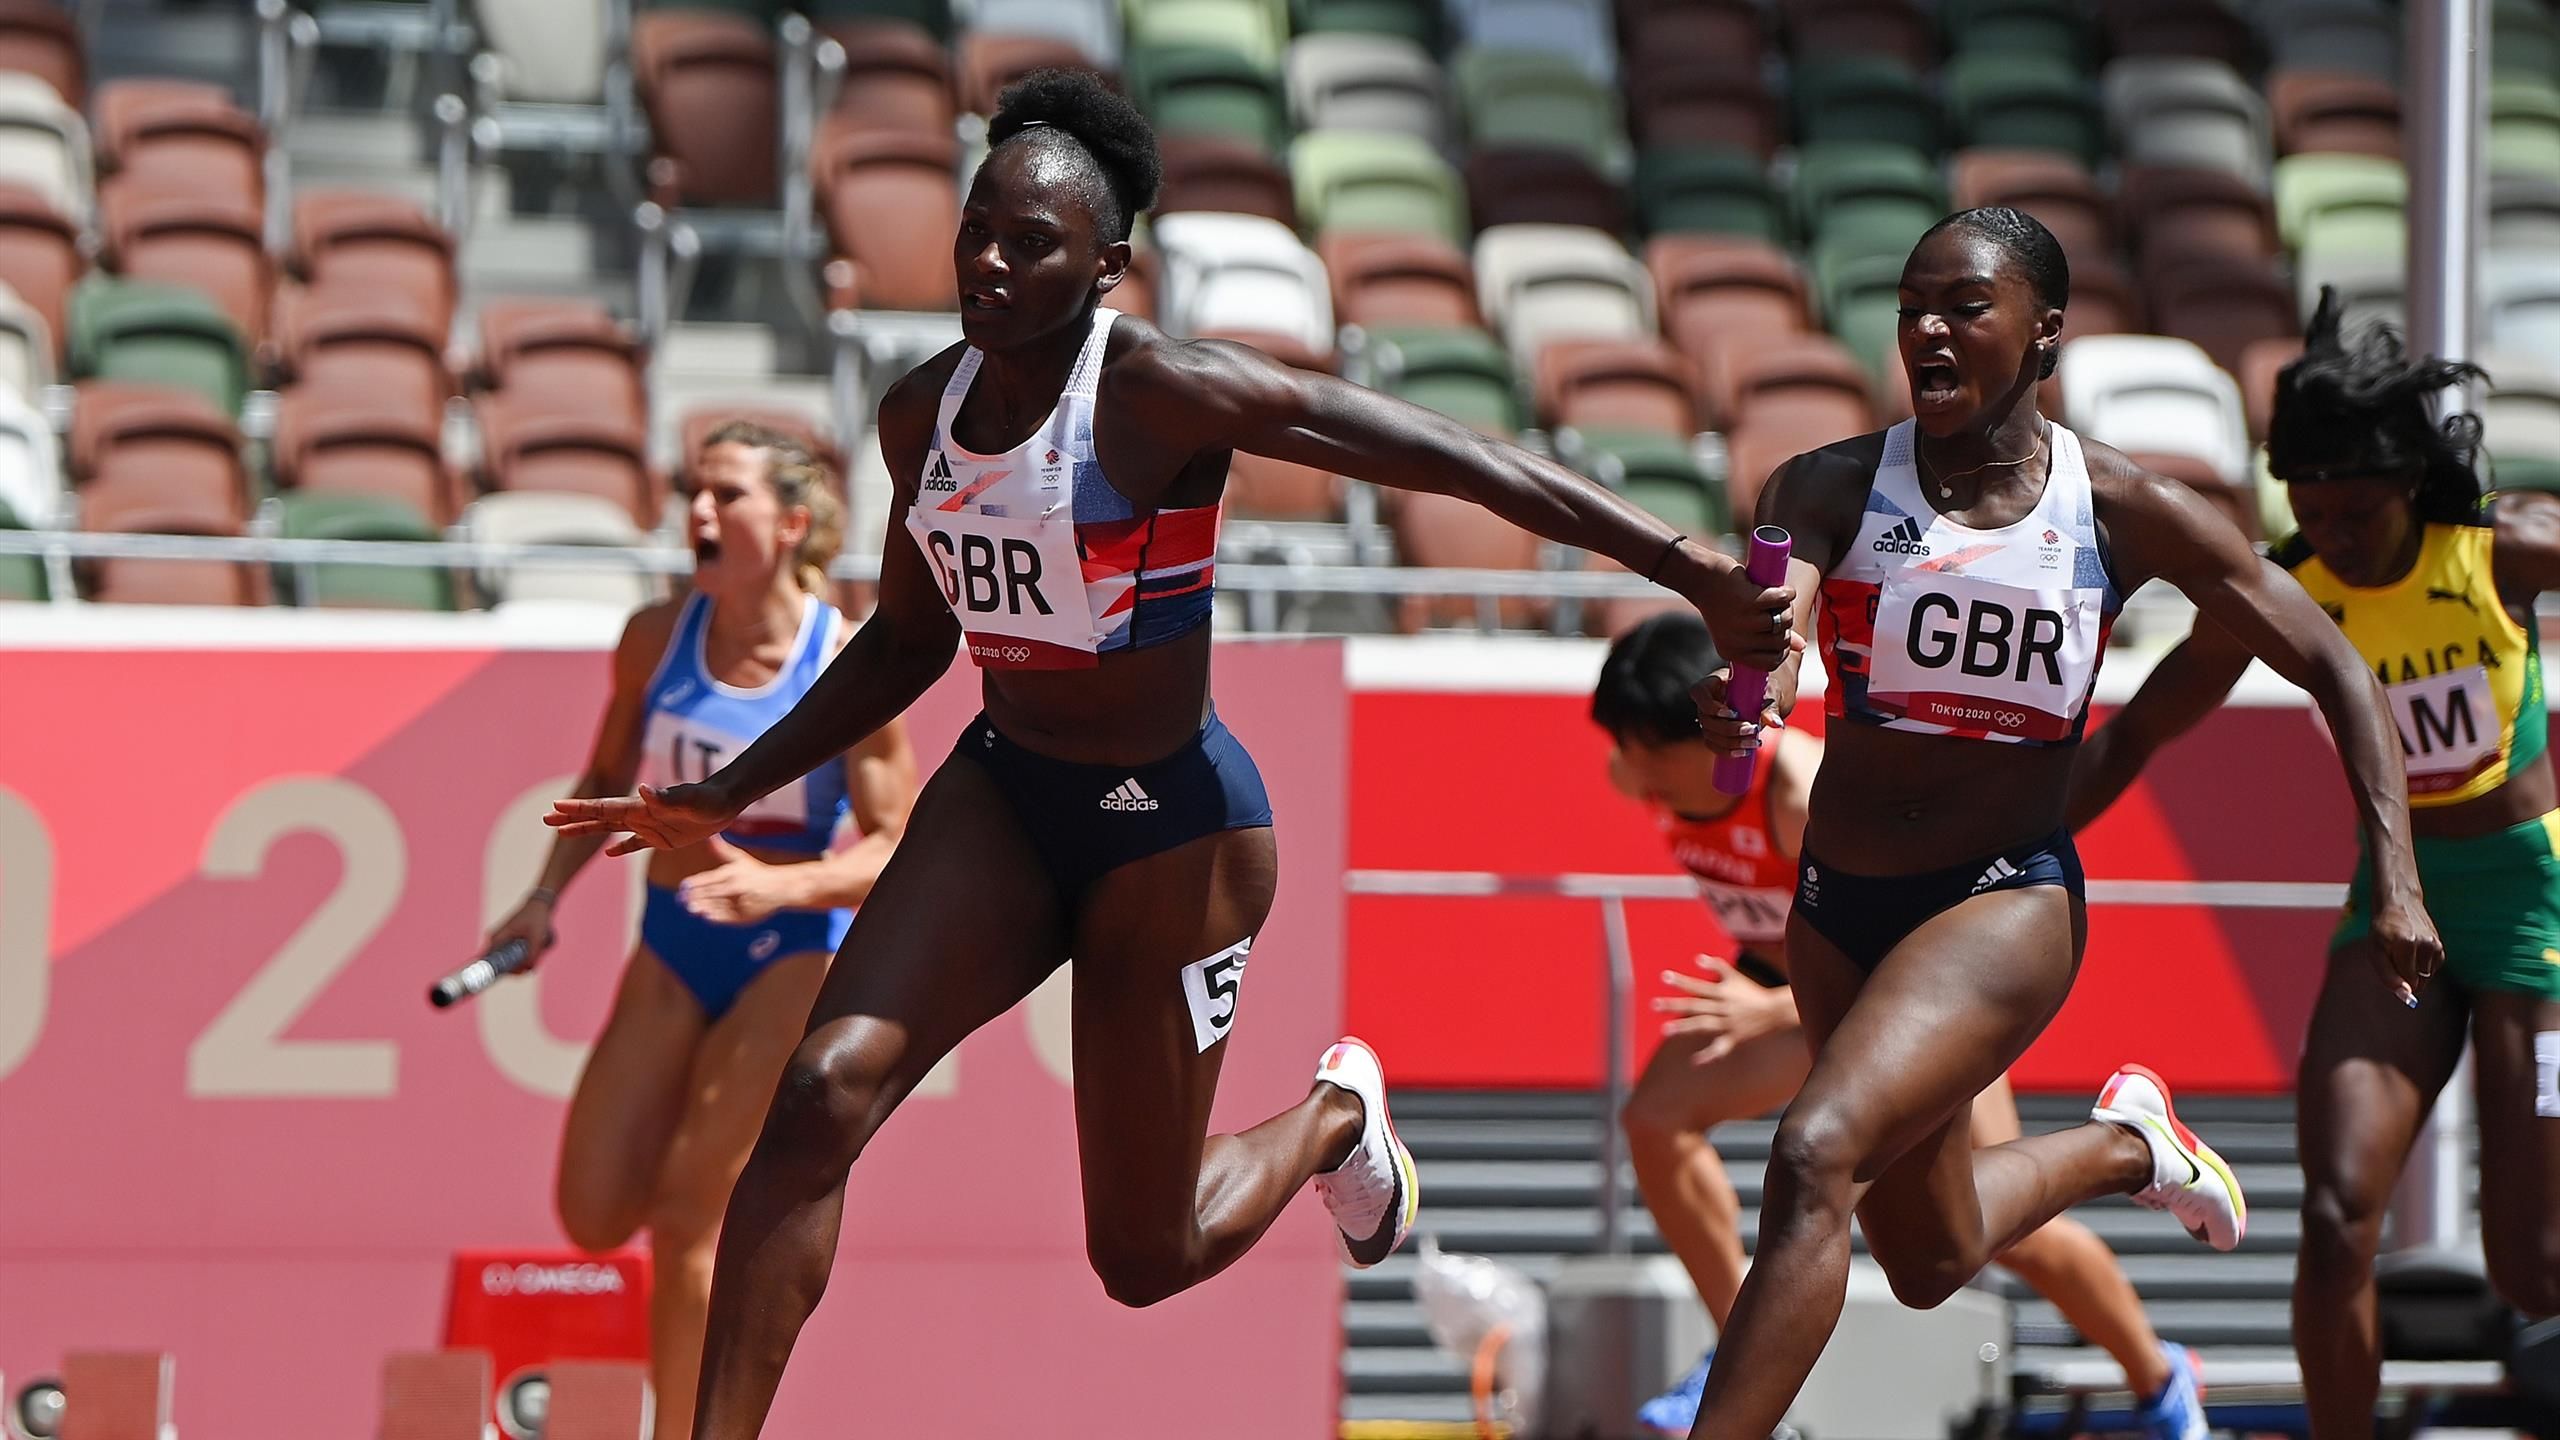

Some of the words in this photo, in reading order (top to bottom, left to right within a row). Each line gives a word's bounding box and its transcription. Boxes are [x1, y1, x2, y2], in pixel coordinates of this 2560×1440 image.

[924, 476, 958, 492] adidas
[1873, 537, 1931, 557] adidas
[927, 529, 1054, 616] GBR
[1906, 592, 2064, 687] GBR
[1930, 702, 1965, 717] TOKYO
[1965, 708, 1991, 720] 2020
[670, 731, 727, 783] IT
[1100, 797, 1159, 811] adidas
[1203, 955, 1238, 1029] 5
